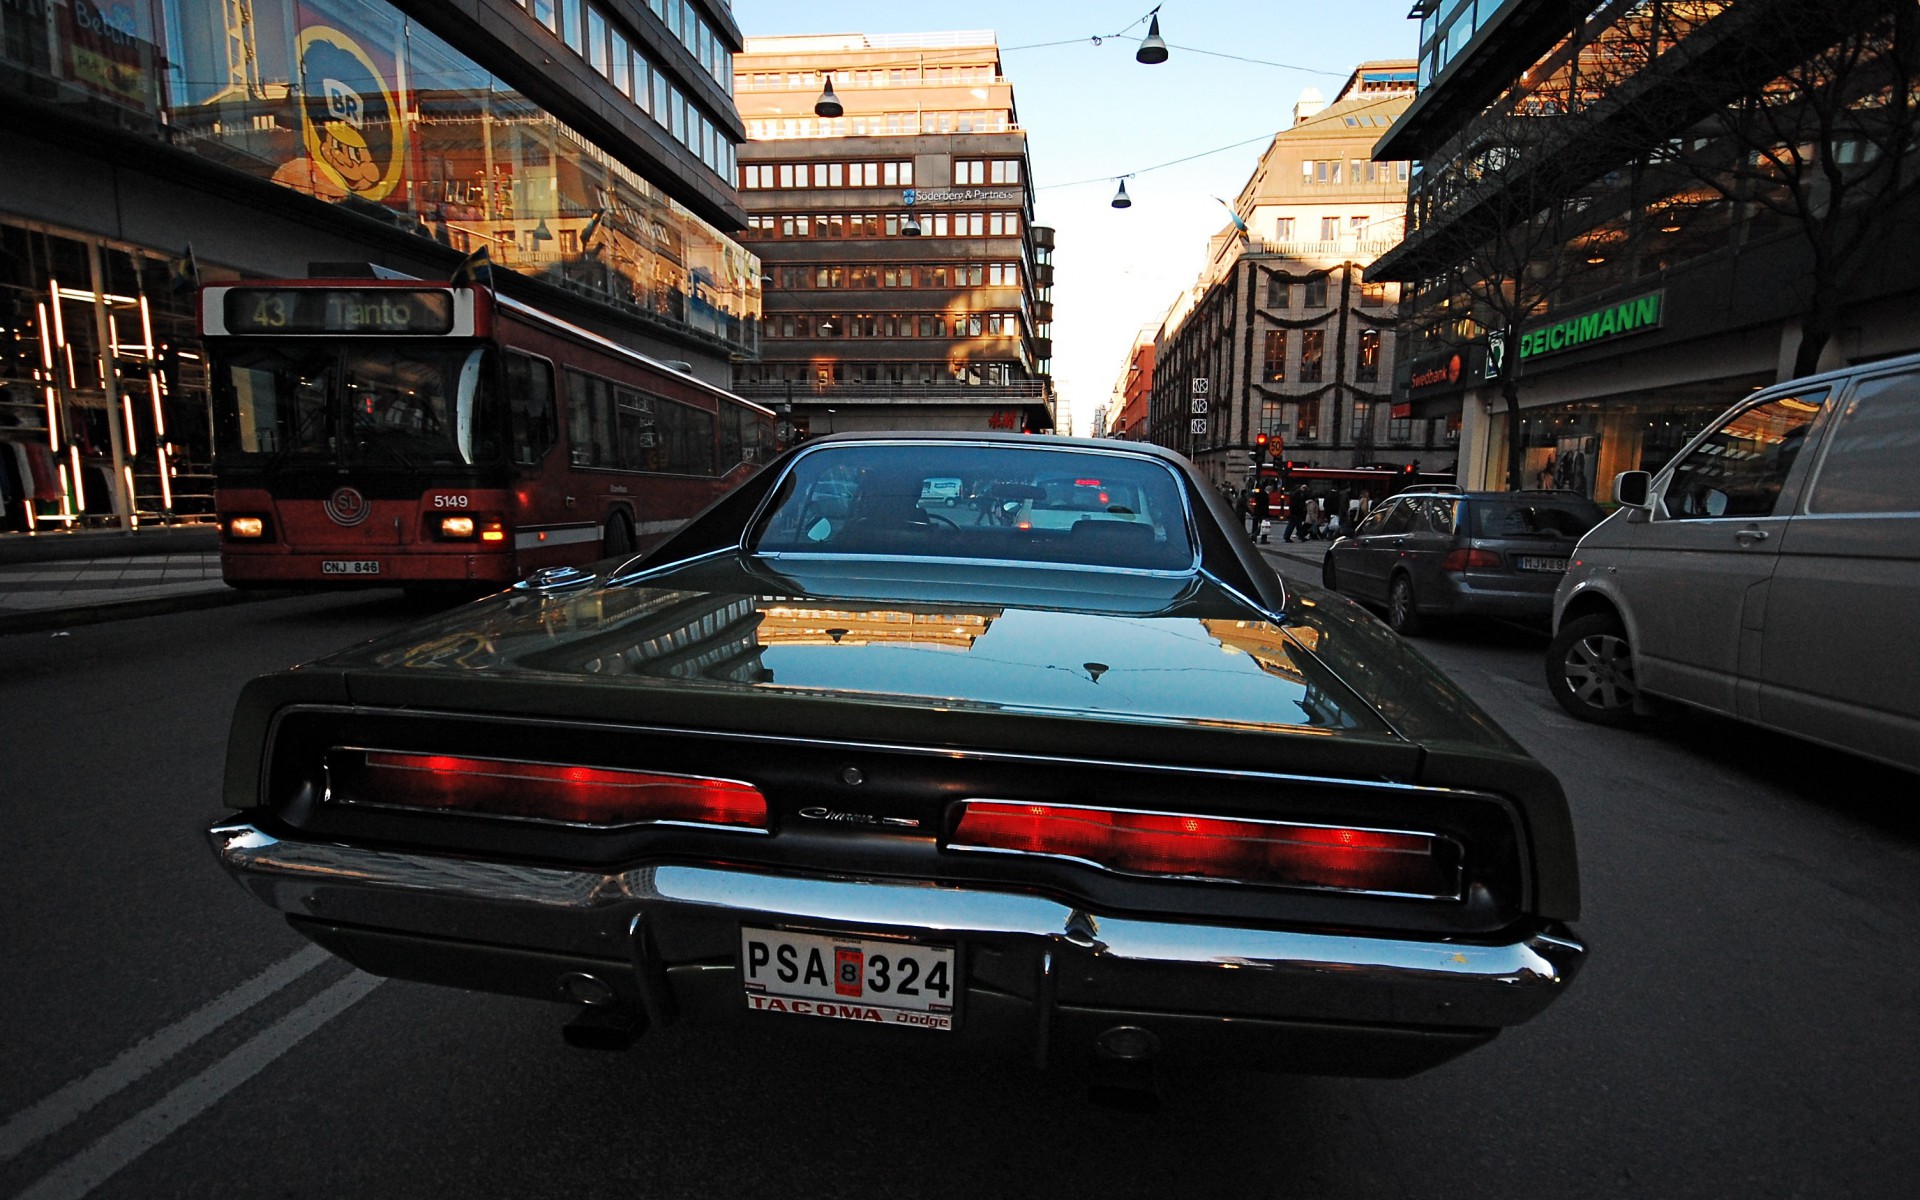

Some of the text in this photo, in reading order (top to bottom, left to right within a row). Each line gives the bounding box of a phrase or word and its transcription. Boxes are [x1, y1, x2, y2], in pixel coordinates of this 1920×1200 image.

[332, 89, 358, 118] BR
[916, 189, 1013, 202] Söderberg & Partners
[252, 297, 411, 327] 43 Tanto
[1519, 294, 1660, 359] DEICHMANN
[1411, 367, 1449, 389] Swedbank
[1271, 441, 1281, 451] 50
[338, 495, 358, 510] SL
[434, 495, 468, 508] 5149
[324, 562, 378, 572] CNJ 846
[1524, 558, 1547, 569] MJW
[748, 941, 950, 998] PSA 8 324
[750, 996, 949, 1028] TACOMA Dodge
